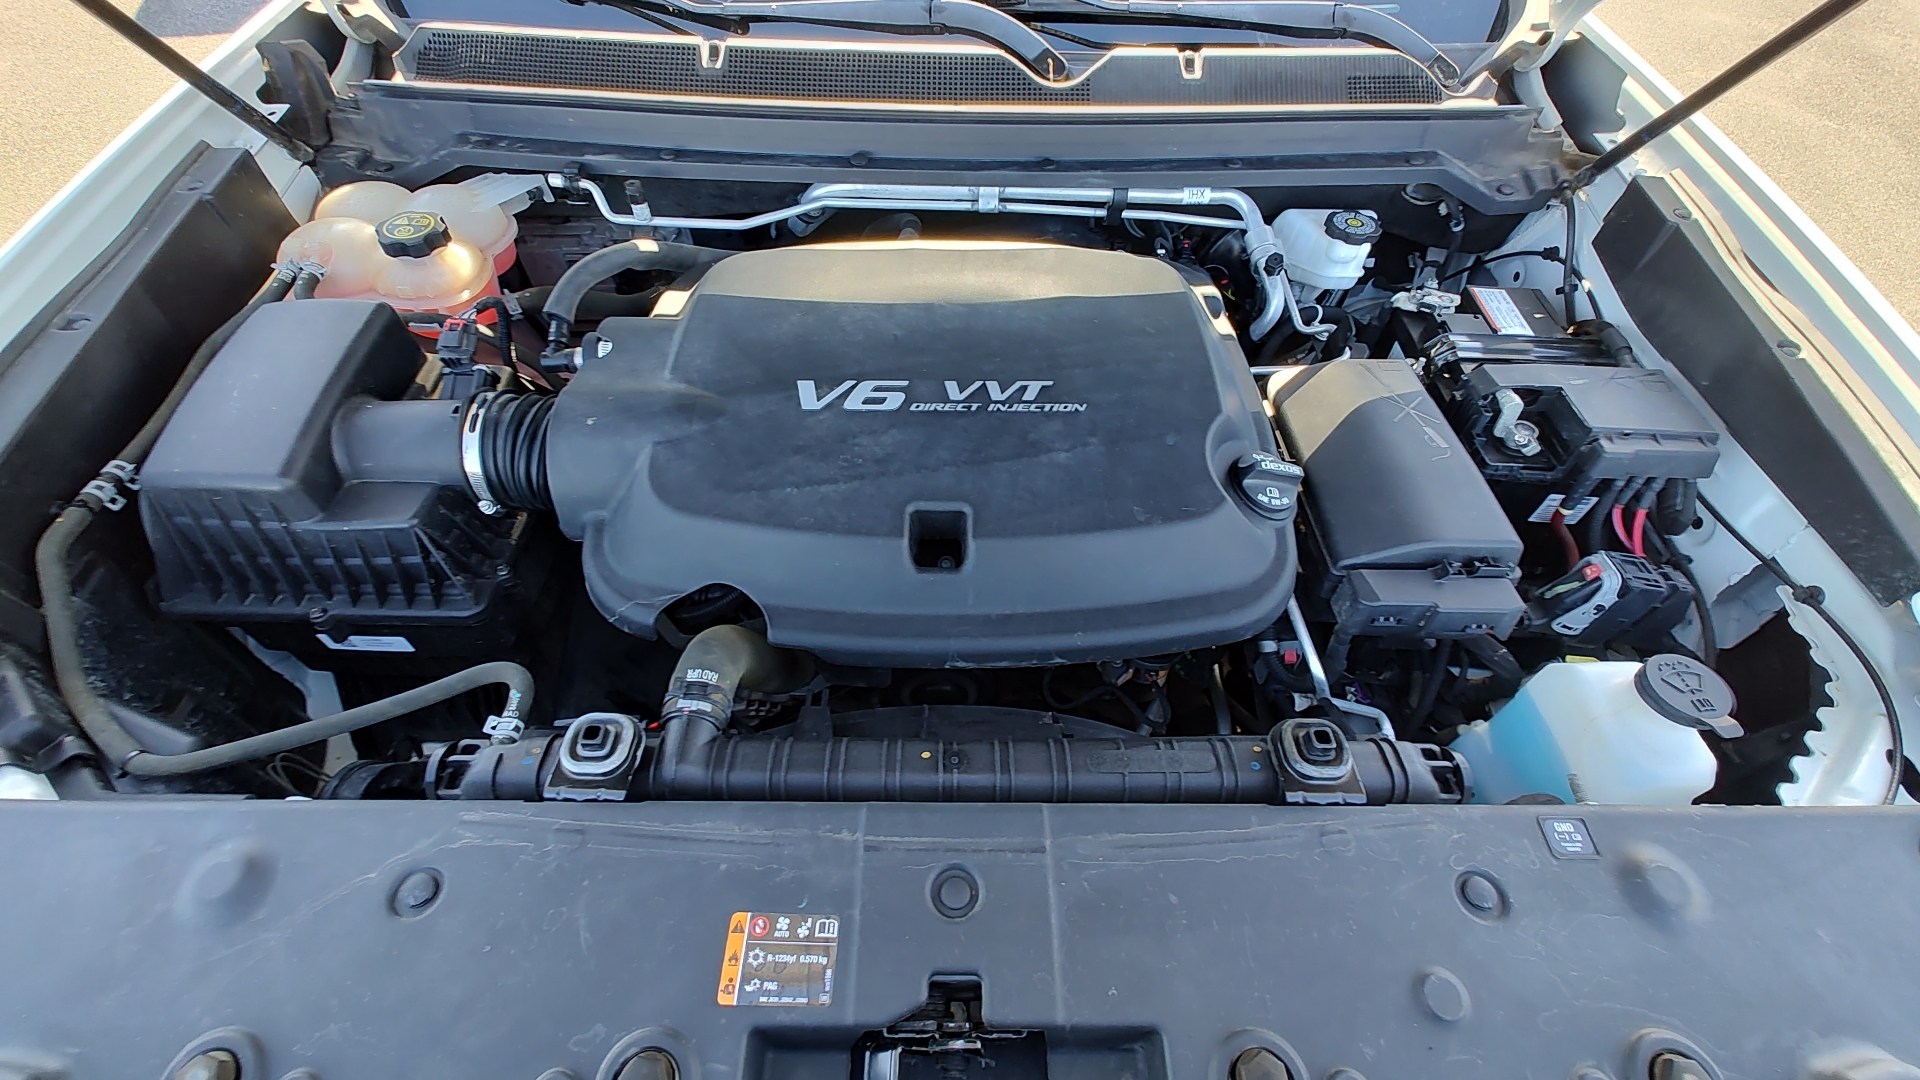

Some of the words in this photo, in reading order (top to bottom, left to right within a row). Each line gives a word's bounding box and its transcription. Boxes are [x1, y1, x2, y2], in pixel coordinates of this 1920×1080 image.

[796, 380, 910, 411] V6
[943, 380, 1055, 401] VVT
[909, 403, 983, 412] DIRECT
[987, 403, 1088, 412] INJECTION
[1260, 460, 1301, 475] dexos
[702, 670, 719, 683] RAD
[1553, 822, 1575, 832] GND
[773, 930, 790, 938] AUTO
[766, 954, 798, 964] R-1234yf
[799, 954, 818, 964] 0.570
[818, 955, 829, 965] kg
[762, 981, 779, 991] PAG
